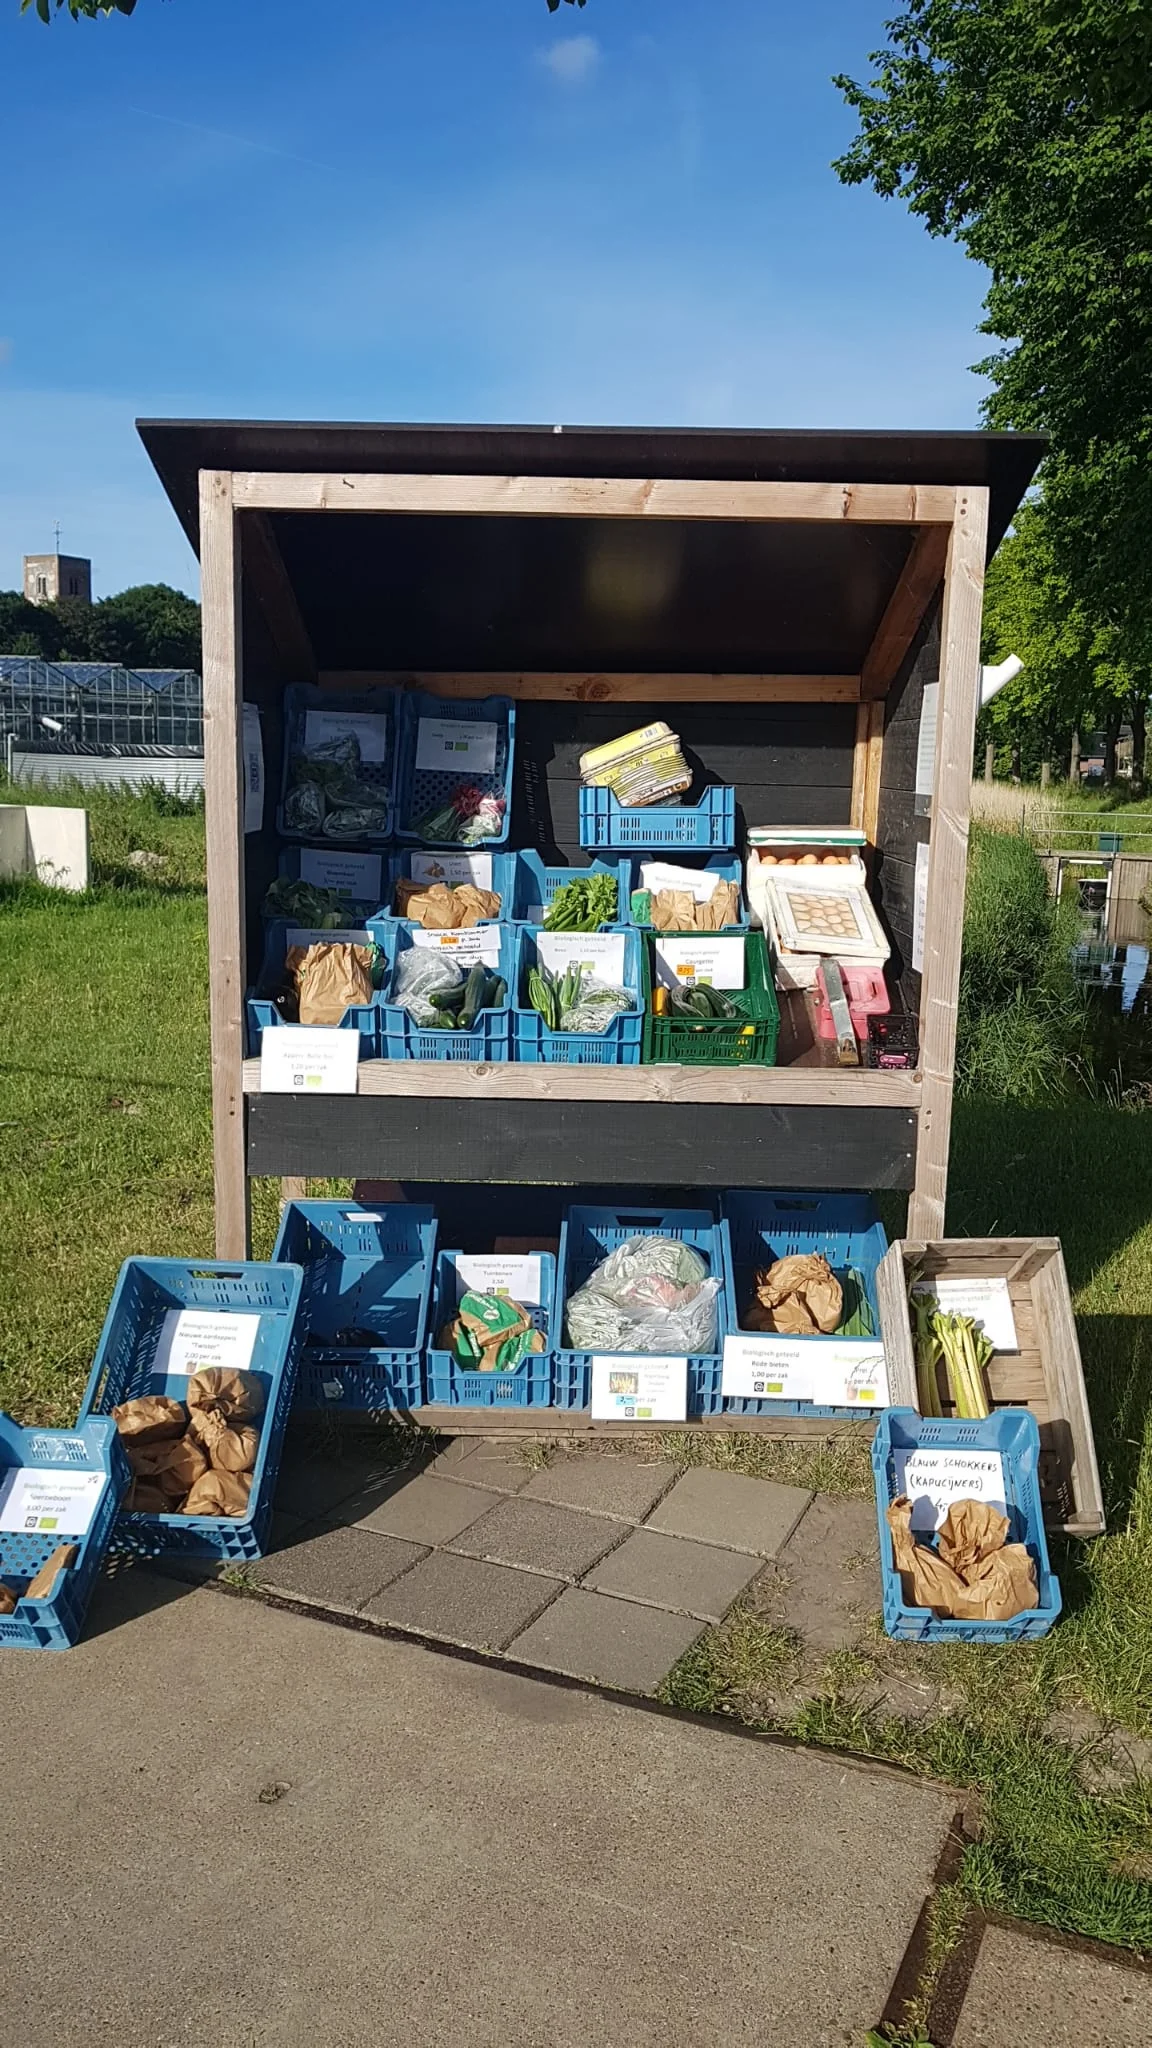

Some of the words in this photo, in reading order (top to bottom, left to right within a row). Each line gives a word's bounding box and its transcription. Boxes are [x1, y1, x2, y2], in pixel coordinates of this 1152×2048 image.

[184, 1351, 199, 1359] 2,00
[742, 1349, 775, 1357] Biologisch
[905, 1456, 940, 1469] BLAUW
[943, 1457, 998, 1473] SCHOKKERS
